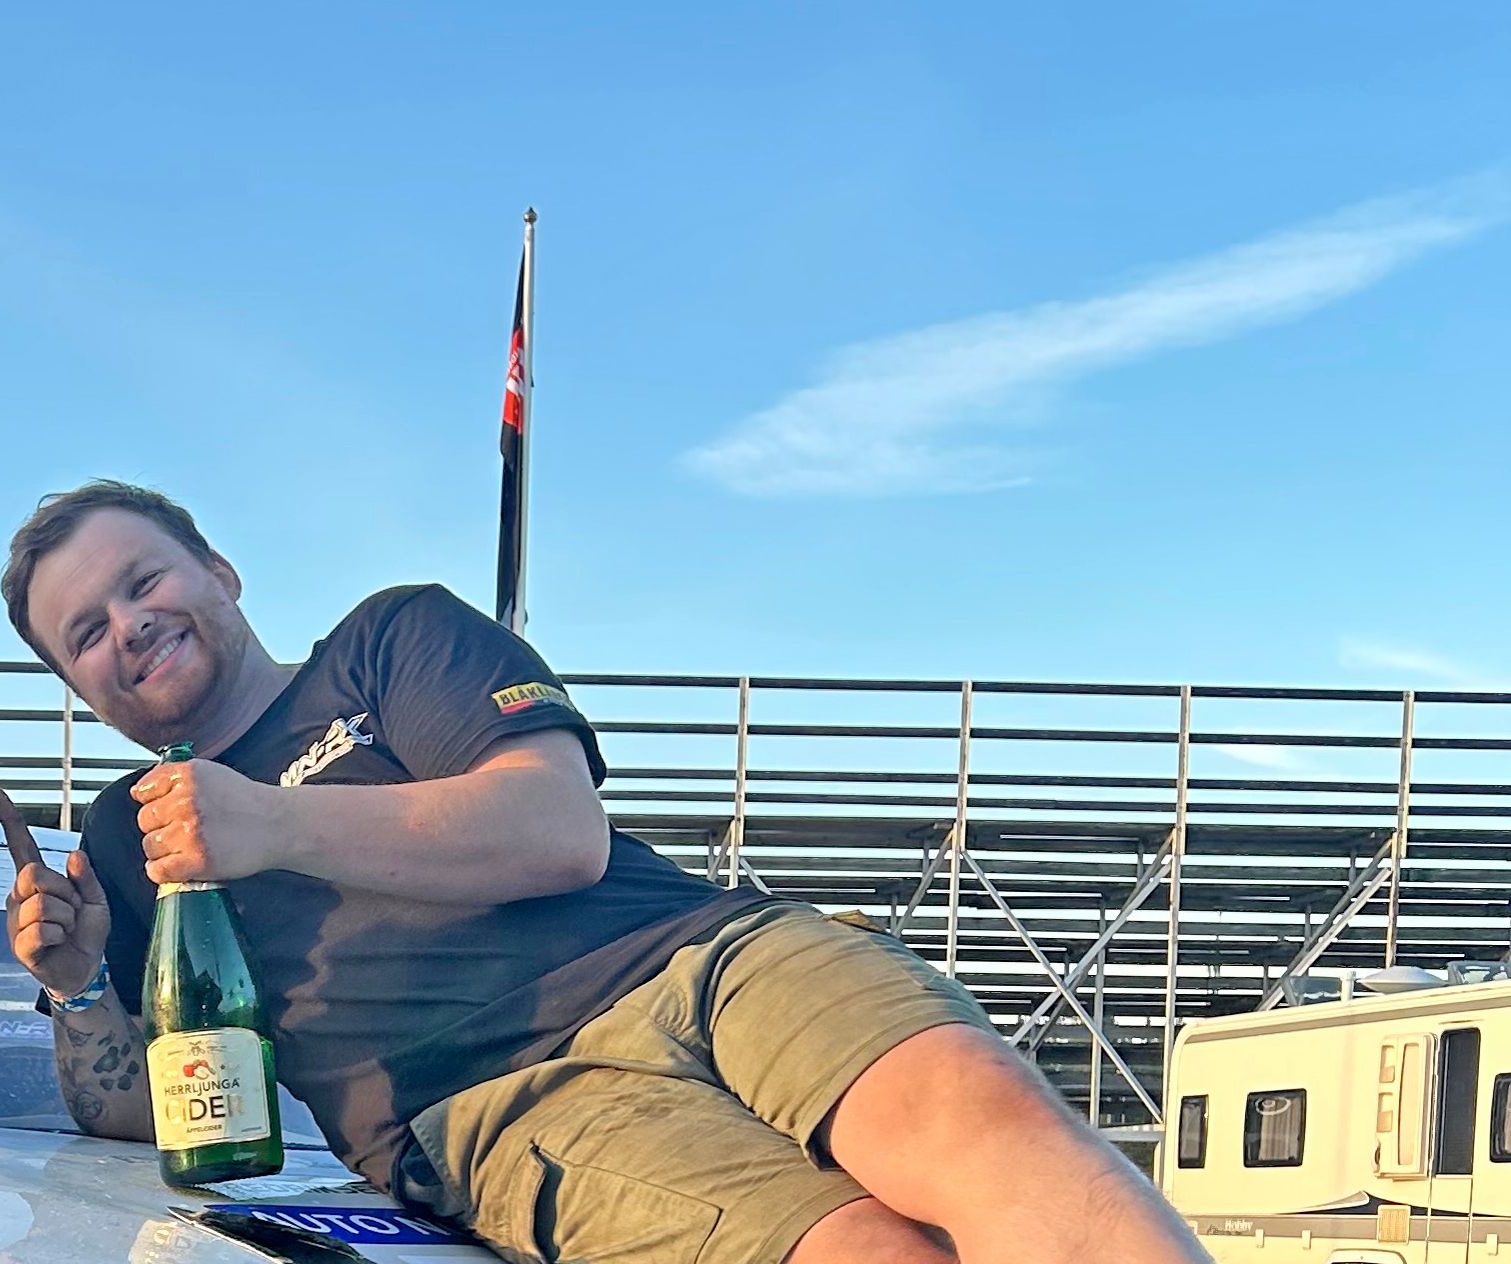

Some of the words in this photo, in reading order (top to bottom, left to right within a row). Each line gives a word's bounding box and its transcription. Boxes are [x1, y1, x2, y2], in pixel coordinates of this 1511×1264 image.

[164, 1078, 241, 1096] HERRLJUNGA
[165, 1094, 244, 1122] CIDER
[251, 1210, 400, 1235] AUTO
